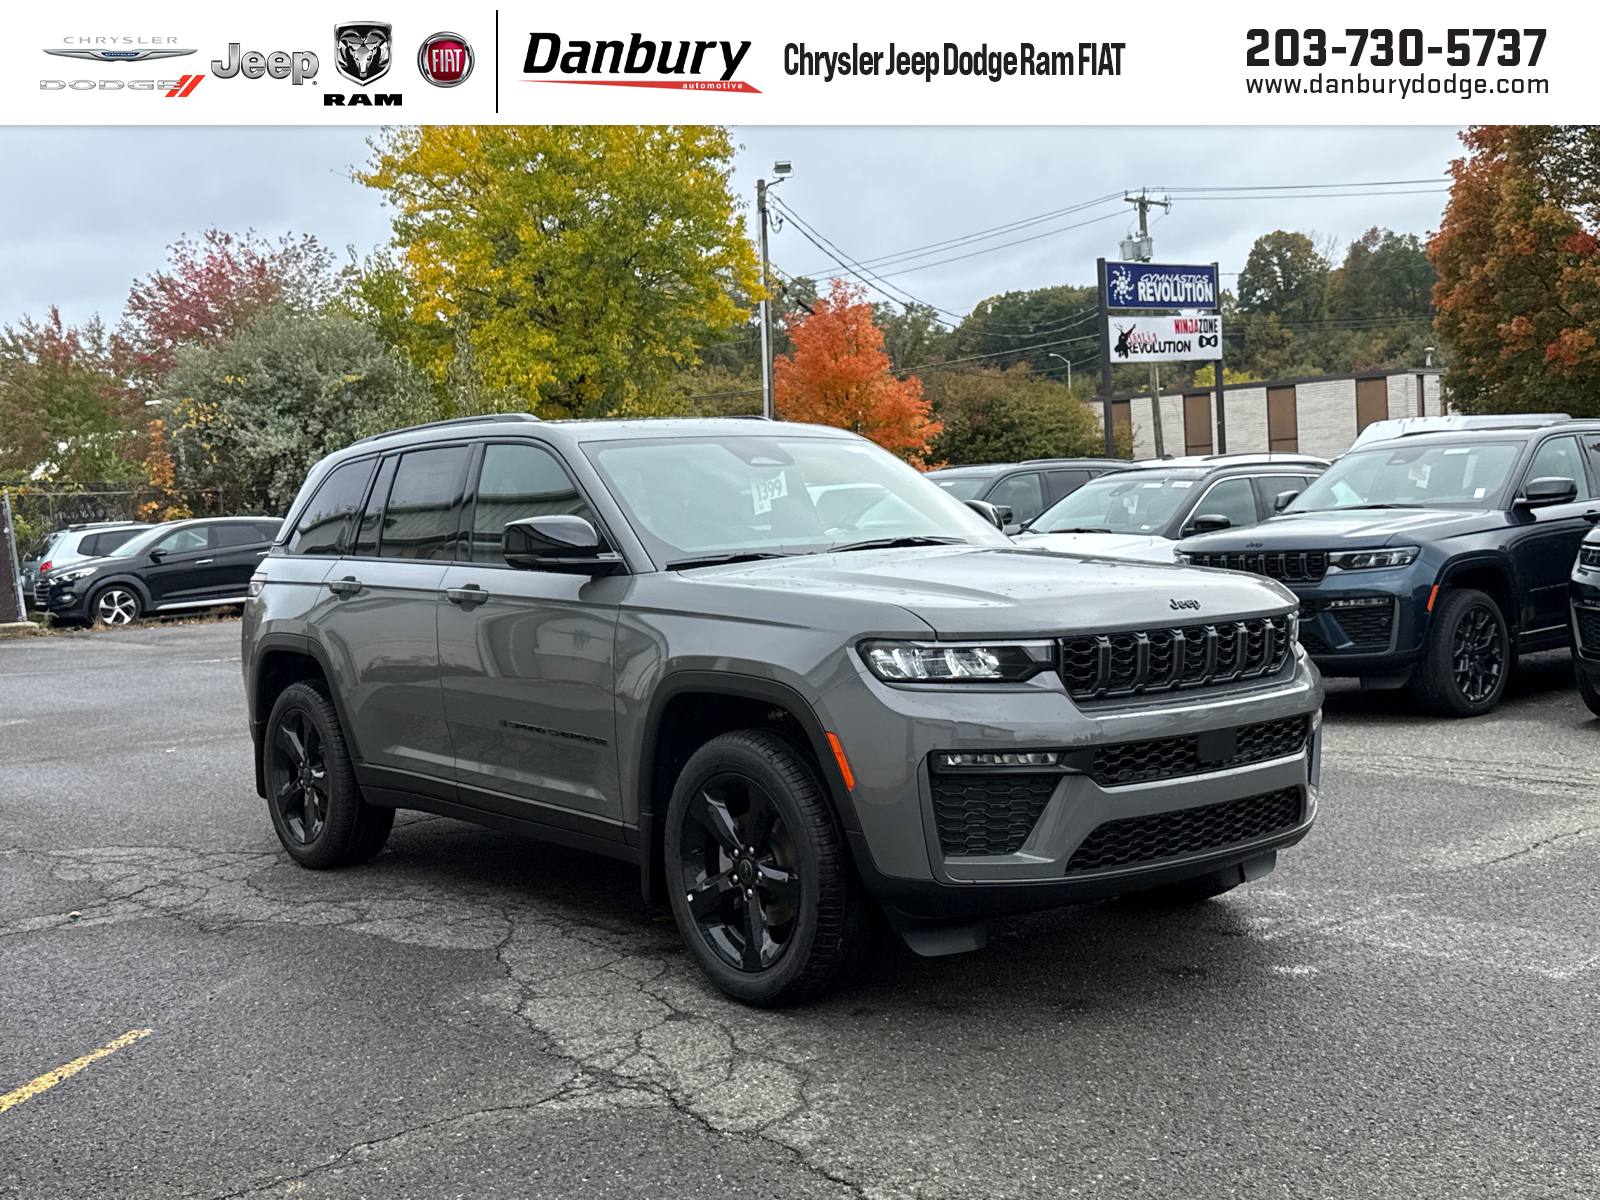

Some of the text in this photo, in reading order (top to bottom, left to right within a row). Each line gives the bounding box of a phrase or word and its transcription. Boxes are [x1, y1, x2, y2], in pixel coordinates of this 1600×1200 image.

[1140, 273, 1210, 284] GYMNASTICS
[1137, 281, 1214, 303] REVOLUTION
[756, 478, 783, 501] 1399
[1170, 598, 1201, 610] Jeep
